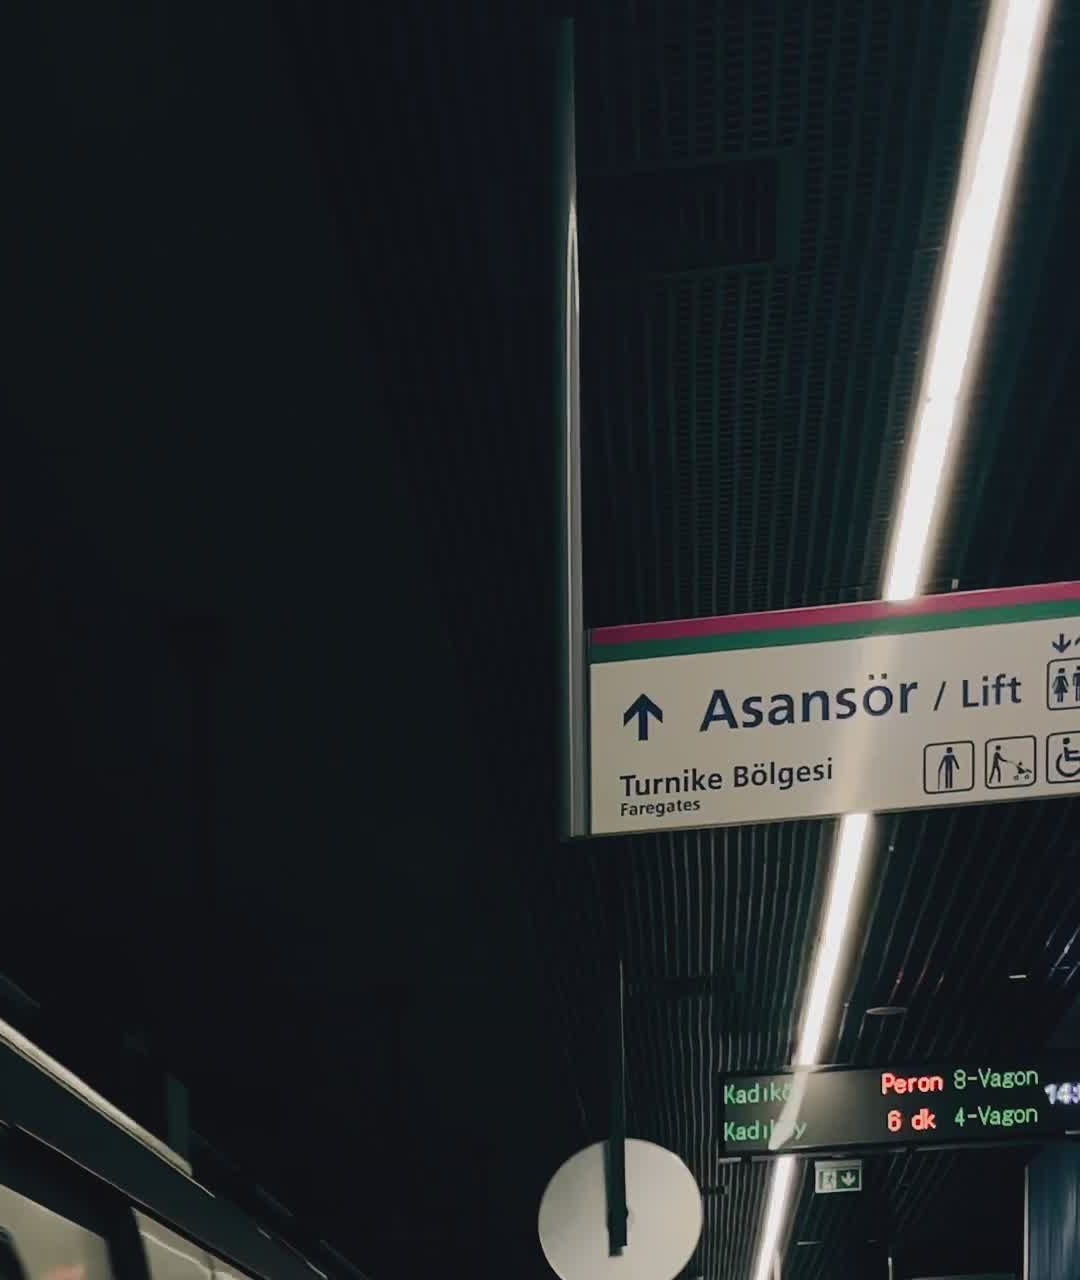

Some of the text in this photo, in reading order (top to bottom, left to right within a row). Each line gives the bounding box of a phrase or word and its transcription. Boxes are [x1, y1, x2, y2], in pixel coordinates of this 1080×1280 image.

[699, 673, 918, 733] Asansör
[962, 673, 1023, 708] Lift
[620, 756, 834, 797] Turnike Bölgesi
[620, 797, 701, 818] Faregates
[723, 1067, 1039, 1105] Kadıkö Peron 8-Vagon
[887, 1110, 903, 1132] 6
[911, 1108, 937, 1130] dk
[954, 1105, 1038, 1128] 4-Vagon
